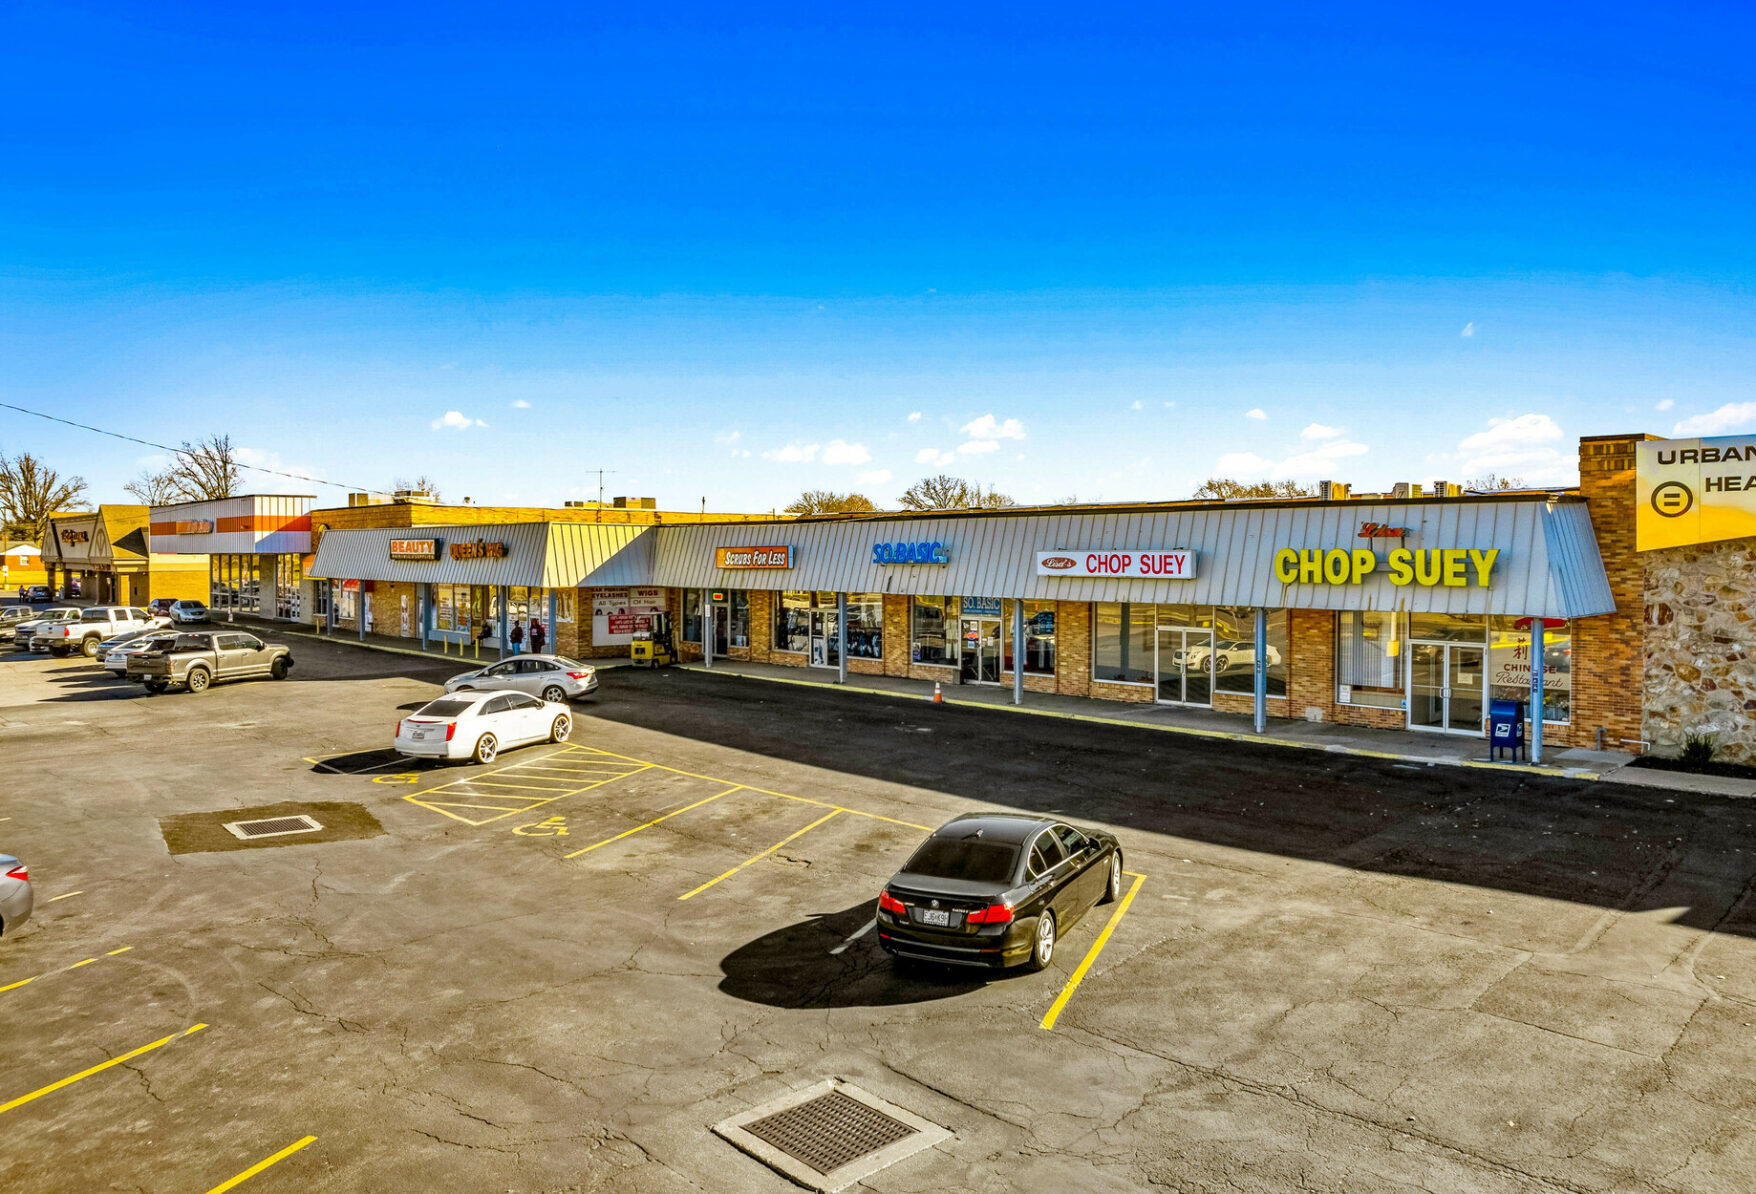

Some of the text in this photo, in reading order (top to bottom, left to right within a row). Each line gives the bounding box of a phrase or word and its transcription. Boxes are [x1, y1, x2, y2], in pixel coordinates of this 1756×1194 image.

[1658, 446, 1756, 465] URBAN
[391, 541, 433, 553] BEAUTY
[1086, 554, 1186, 575] CHOP SUEY
[1274, 548, 1500, 587] CHOP SUEY
[977, 597, 1001, 610] BASIC
